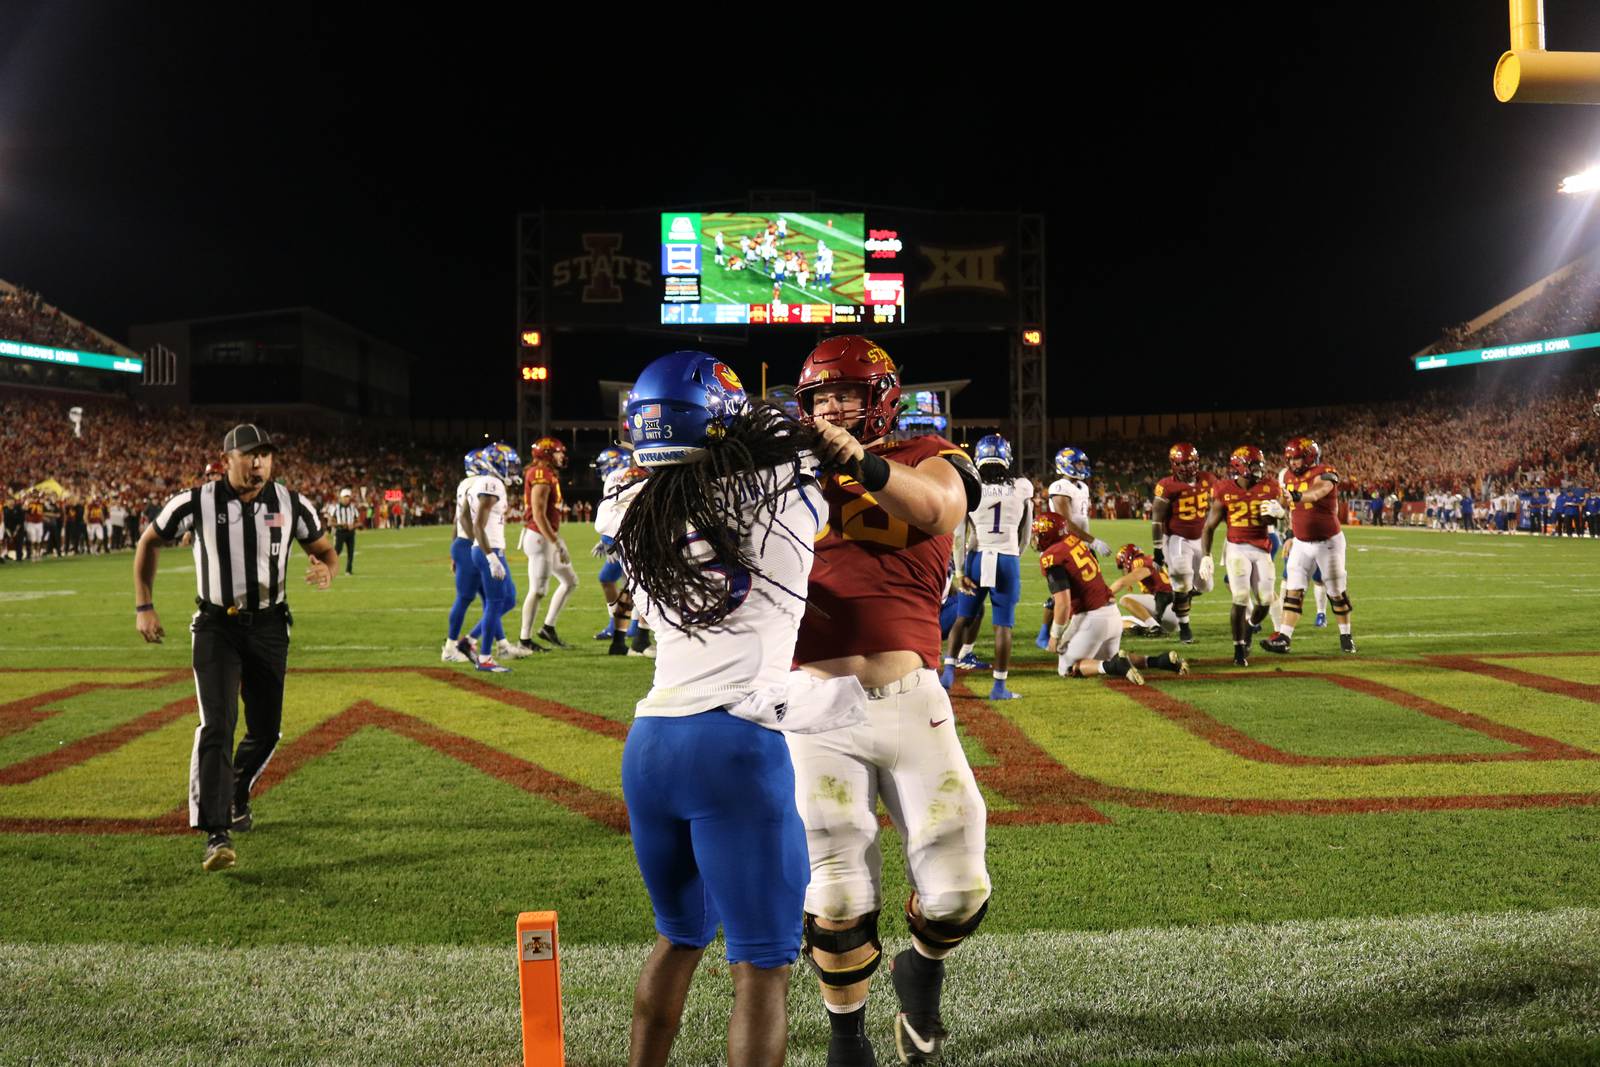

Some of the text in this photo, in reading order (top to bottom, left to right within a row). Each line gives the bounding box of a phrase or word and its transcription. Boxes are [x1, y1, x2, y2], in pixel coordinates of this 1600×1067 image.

[551, 255, 653, 288] STATE
[0, 341, 20, 355] ORN
[1481, 348, 1507, 360] CORN
[1544, 339, 1571, 351] IOWA
[663, 424, 673, 439] 3
[981, 486, 1003, 498] OGAN
[1178, 492, 1209, 521] 55
[217, 513, 227, 525] S
[987, 501, 1005, 535] 1
[271, 542, 281, 556] U
[1041, 555, 1055, 569] 57
